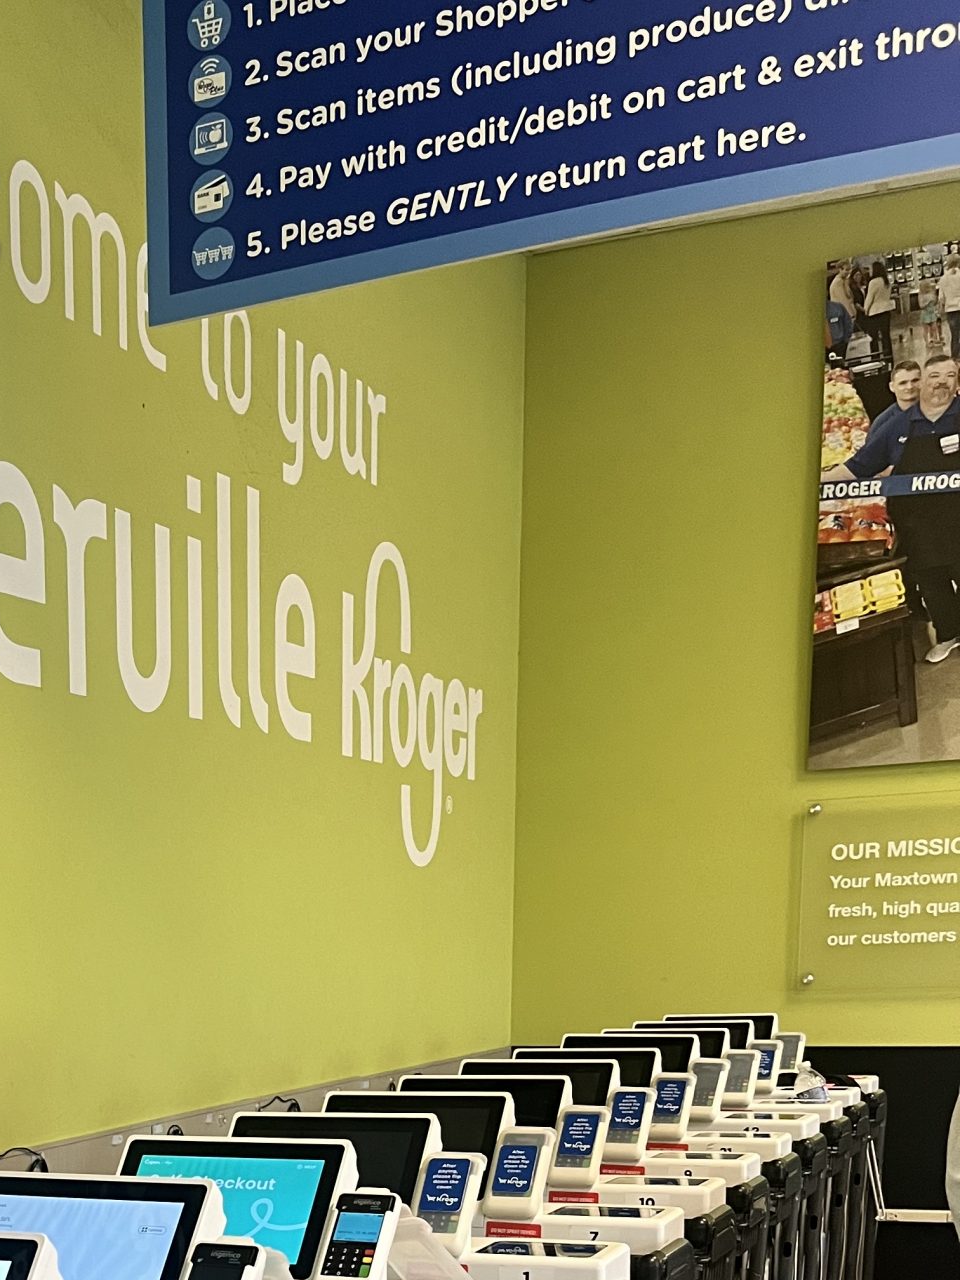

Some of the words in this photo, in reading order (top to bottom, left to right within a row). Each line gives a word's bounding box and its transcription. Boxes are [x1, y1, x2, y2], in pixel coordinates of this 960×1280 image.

[243, 2, 263, 28] 1.
[270, 0, 346, 22] Pla
[244, 59, 269, 86] 2.
[276, 42, 346, 77] Scan
[355, 21, 426, 63] your
[245, 115, 270, 143] 3.
[276, 100, 346, 135] Scan
[357, 77, 441, 116] items
[451, 35, 616, 96] (including
[628, 0, 792, 58] produce)
[245, 172, 272, 198] 4.
[279, 161, 332, 193] Pay
[341, 139, 406, 178] with
[416, 93, 612, 160] credit/debit
[622, 86, 665, 114] on
[677, 64, 746, 102] cart
[757, 55, 782, 86] &
[793, 38, 864, 78] exit
[875, 21, 960, 61] thro
[246, 230, 271, 257] 5.
[281, 211, 376, 250] Please
[386, 172, 518, 225] GENTLY
[525, 155, 626, 196] return
[637, 135, 706, 172] cart
[717, 121, 807, 157] here.
[277, 328, 387, 487] your
[341, 540, 484, 868] Kroger
[831, 842, 880, 861] OUR
[830, 875, 871, 889] Your
[875, 872, 958, 888] Maxtown
[828, 903, 878, 918] fresh,
[882, 900, 921, 918] high
[926, 901, 960, 917] qua
[827, 934, 858, 946] our
[861, 930, 957, 946] customers
[589, 1231, 599, 1242] 7
